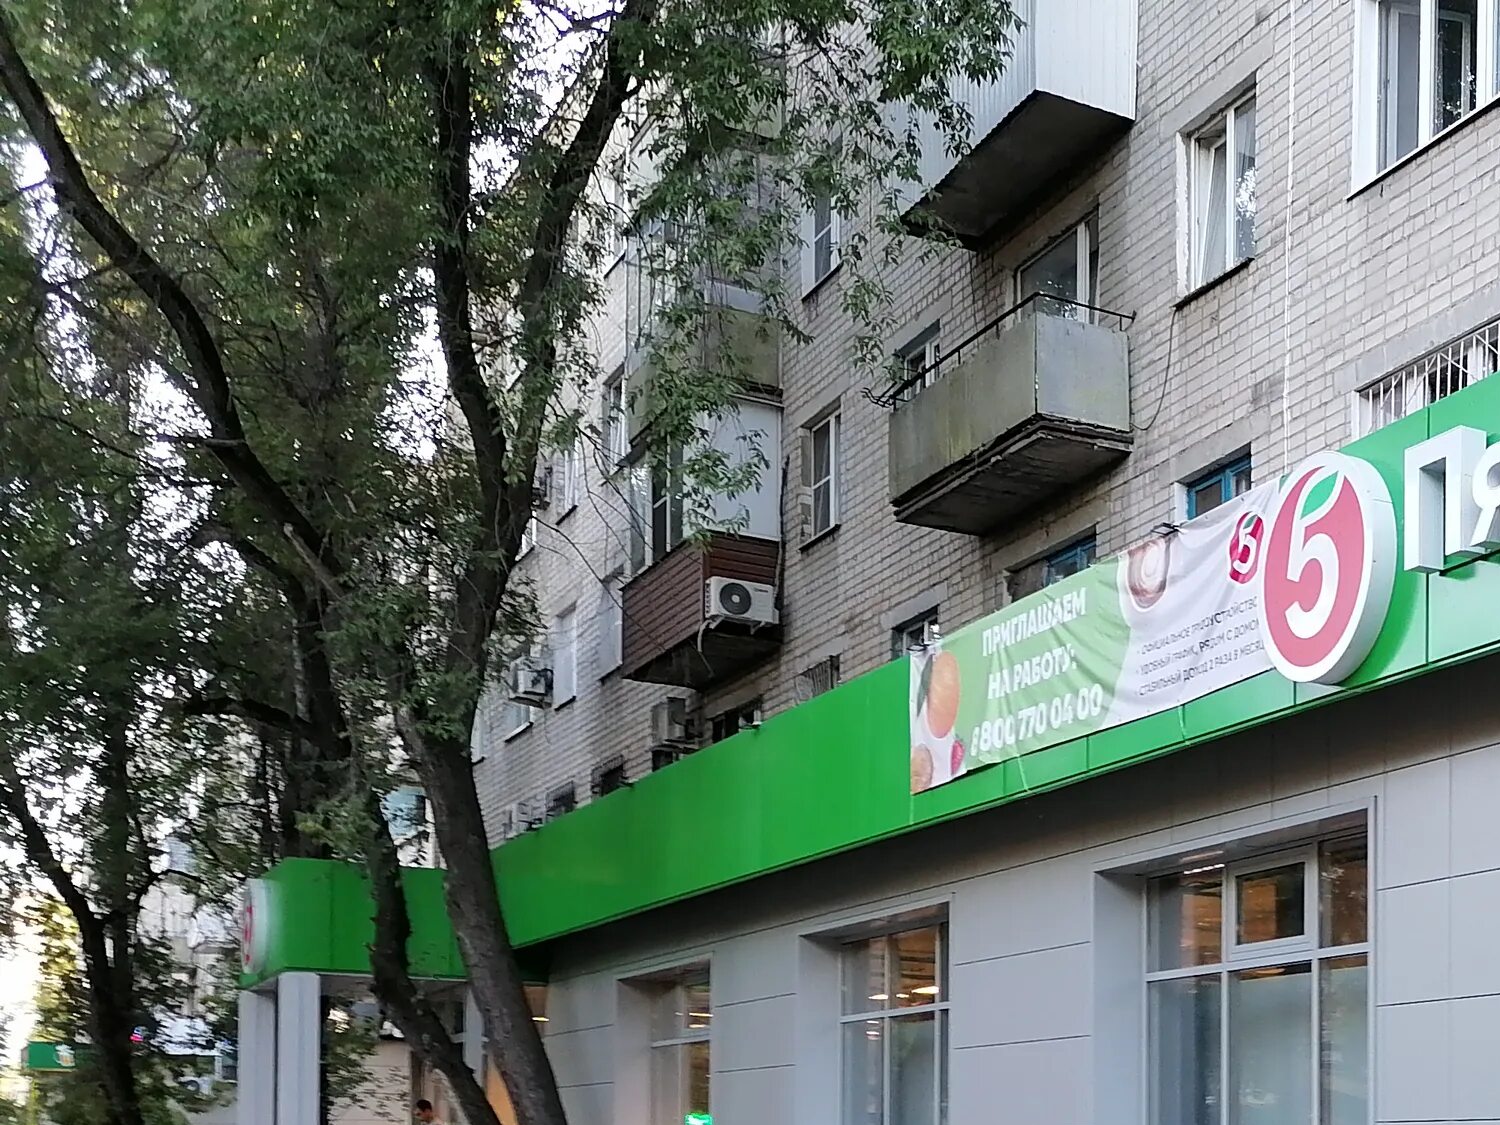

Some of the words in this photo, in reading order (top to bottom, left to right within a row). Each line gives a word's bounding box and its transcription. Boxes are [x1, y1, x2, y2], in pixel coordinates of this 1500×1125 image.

[1285, 468, 1342, 639] 5
[982, 587, 1087, 657] ПРИГЛАШАЕМ
[987, 669, 1011, 699] НА
[1077, 683, 1104, 721] 00
